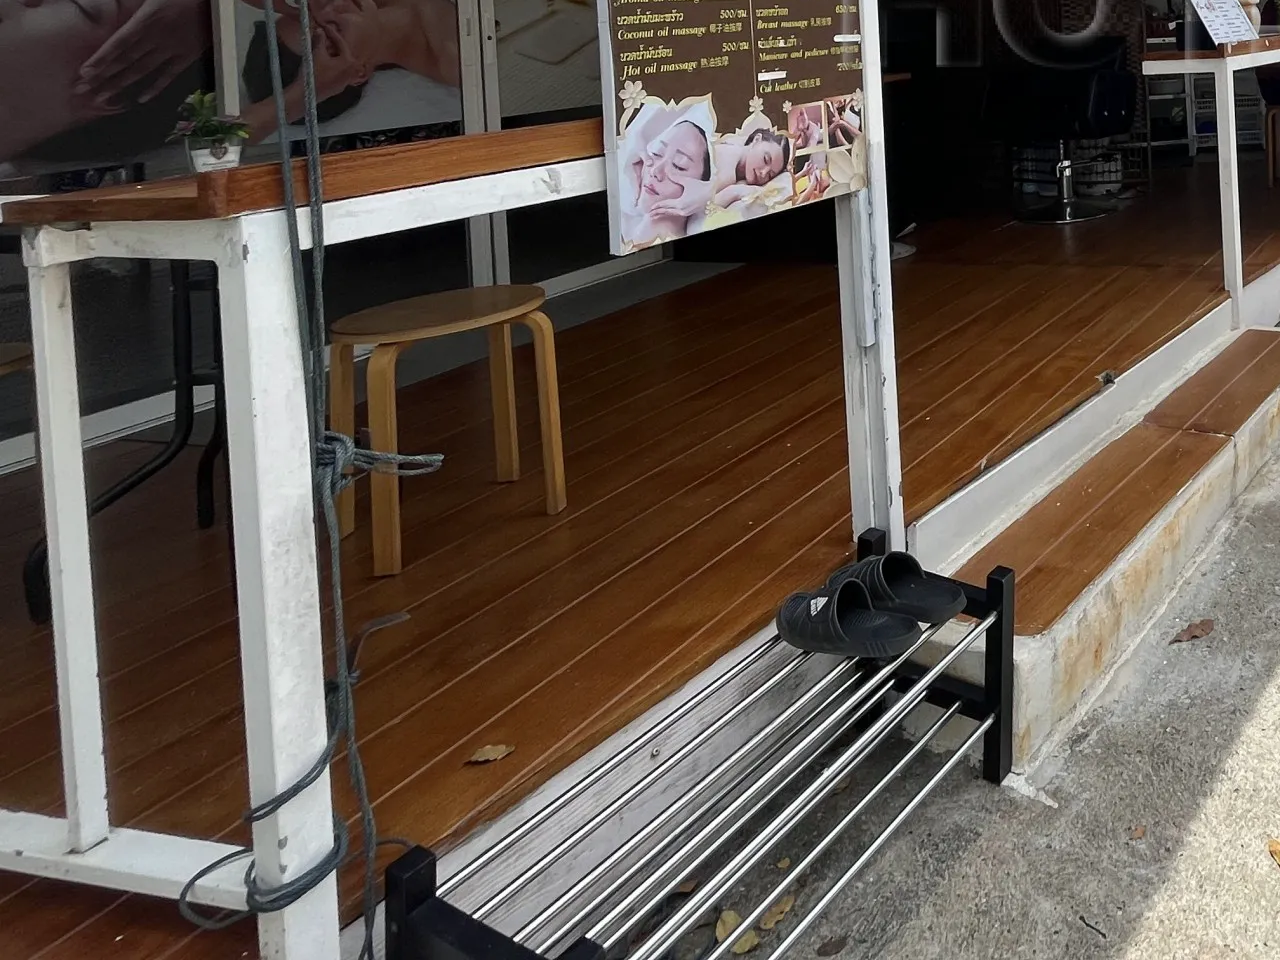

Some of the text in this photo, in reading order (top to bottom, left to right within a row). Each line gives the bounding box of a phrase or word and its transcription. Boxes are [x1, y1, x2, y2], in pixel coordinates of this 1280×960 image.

[757, 20, 808, 29] Breast massage
[618, 27, 706, 40] Coconut oil massage
[791, 50, 802, 58] and
[805, 48, 828, 58] pedicure
[620, 61, 698, 80] Hot oil massage
[775, 82, 797, 91] leather
